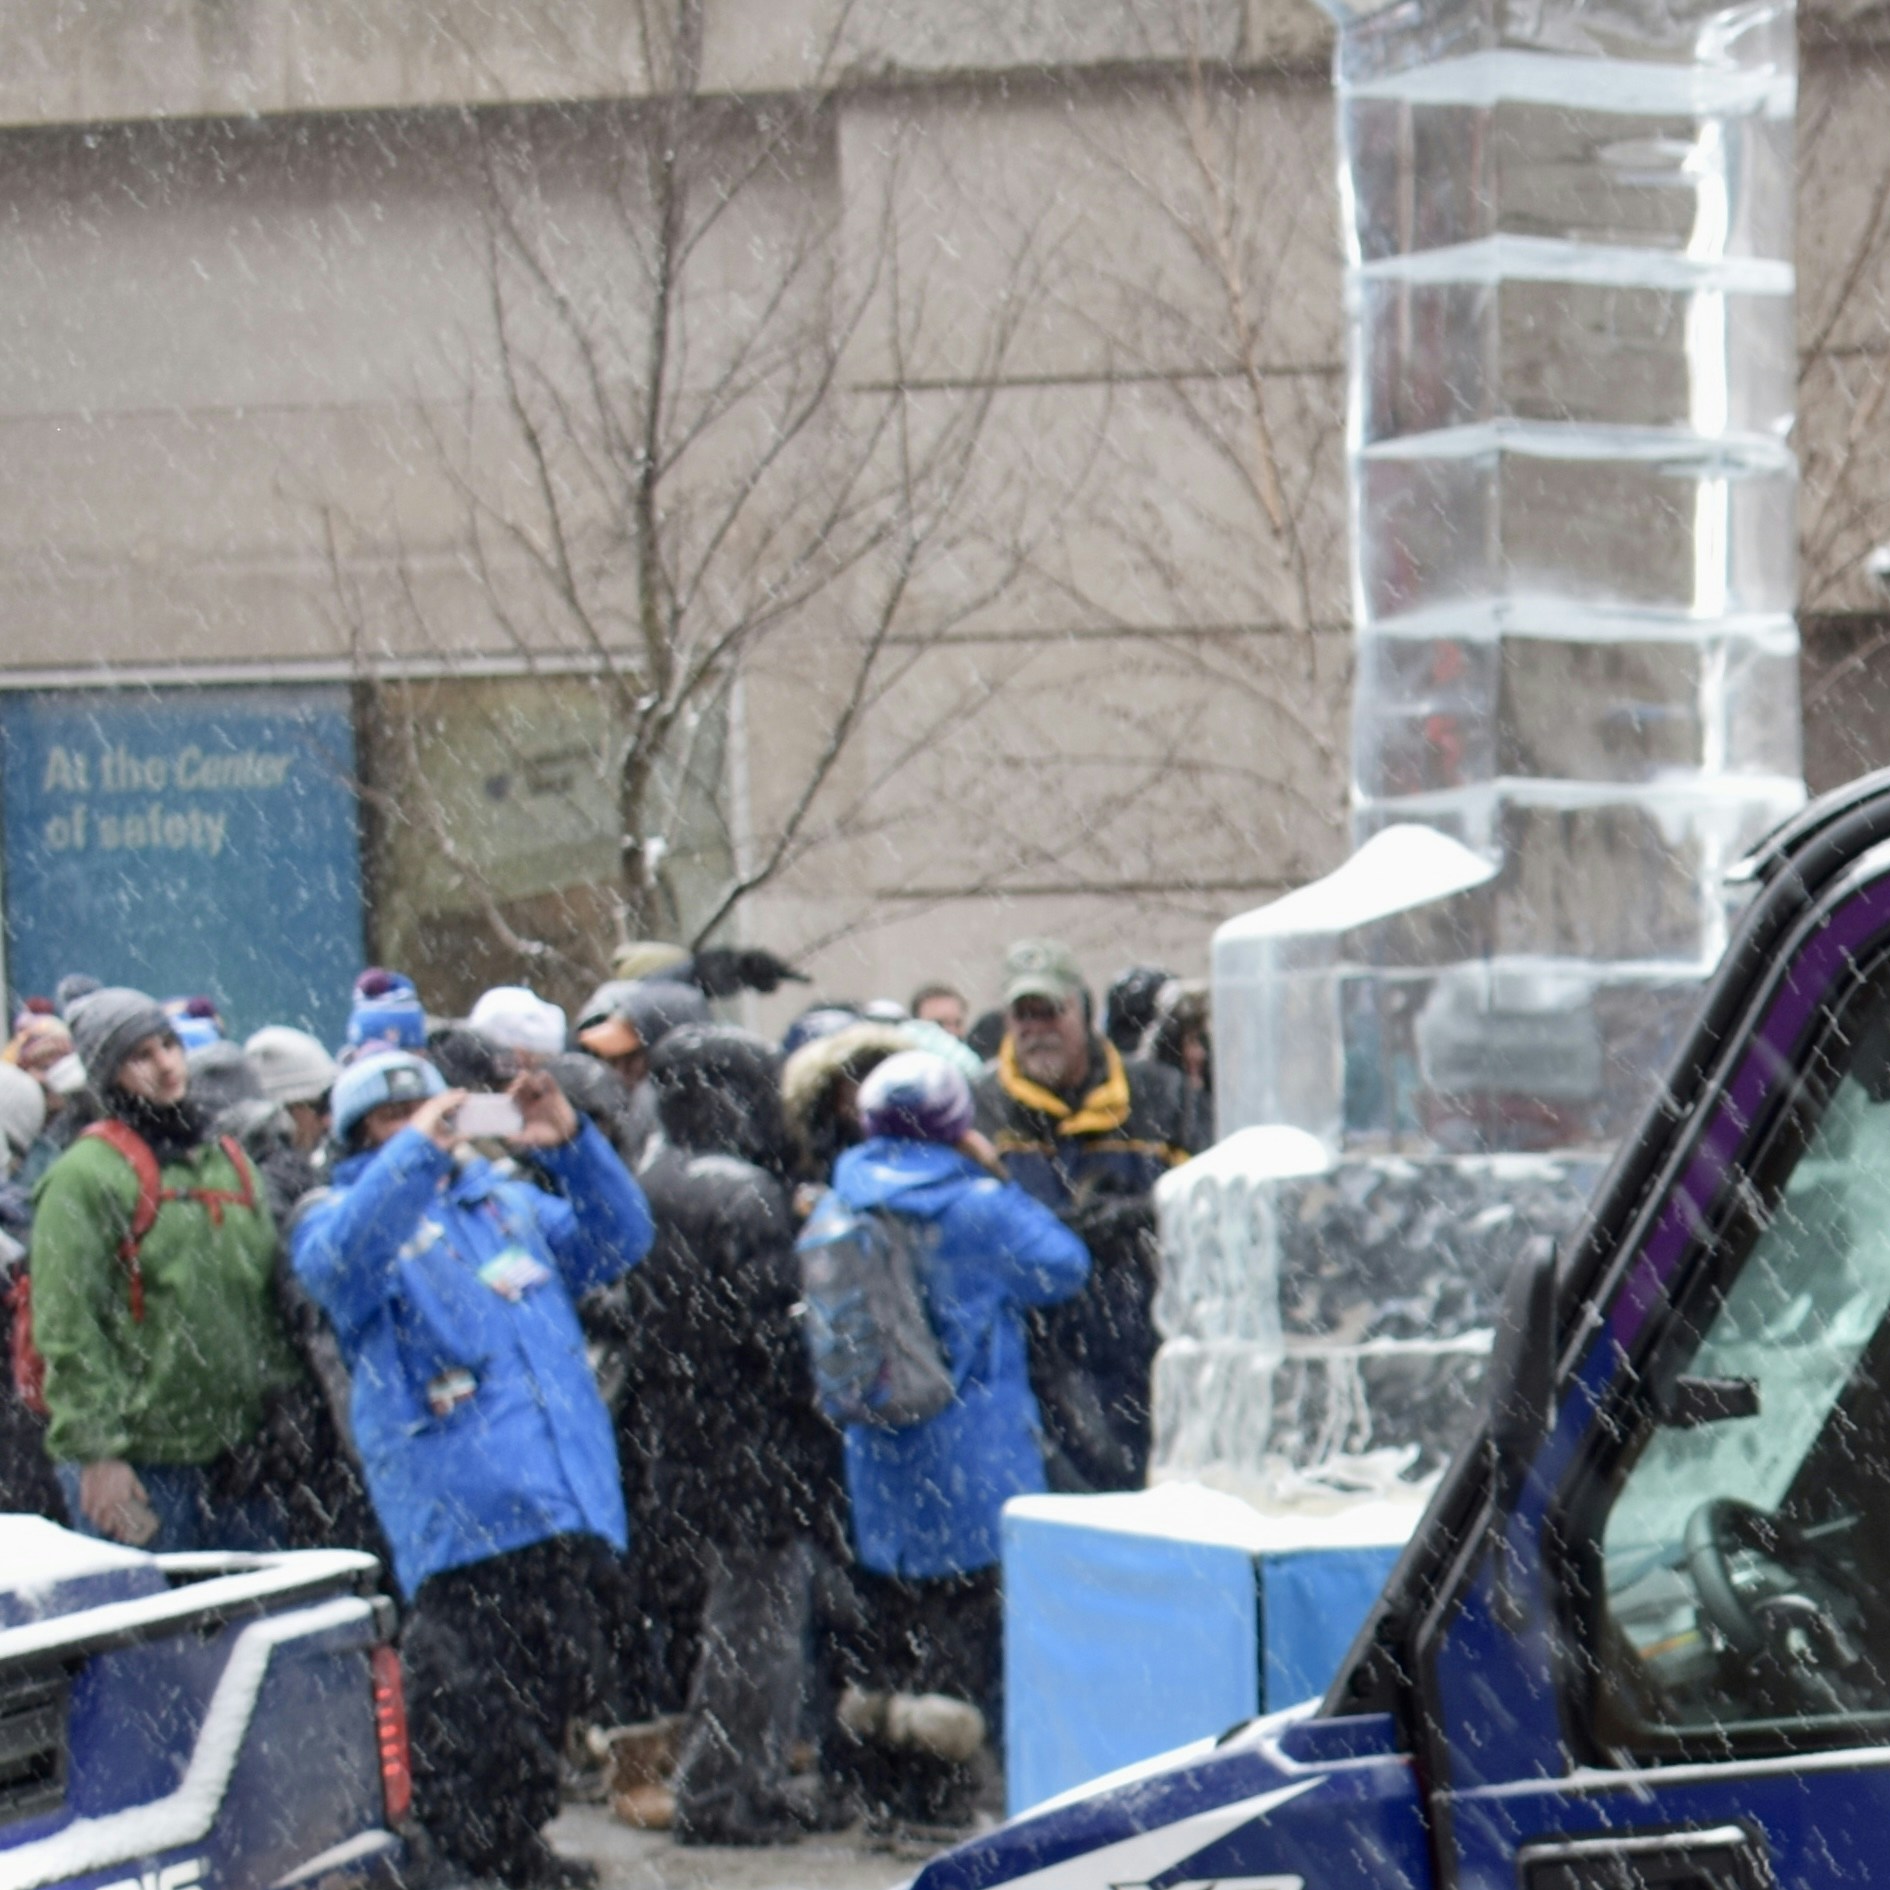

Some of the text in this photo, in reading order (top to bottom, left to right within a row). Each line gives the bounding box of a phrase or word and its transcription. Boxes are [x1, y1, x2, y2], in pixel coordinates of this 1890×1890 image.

[45, 745, 292, 793] At the Center
[46, 800, 226, 858] of safety
